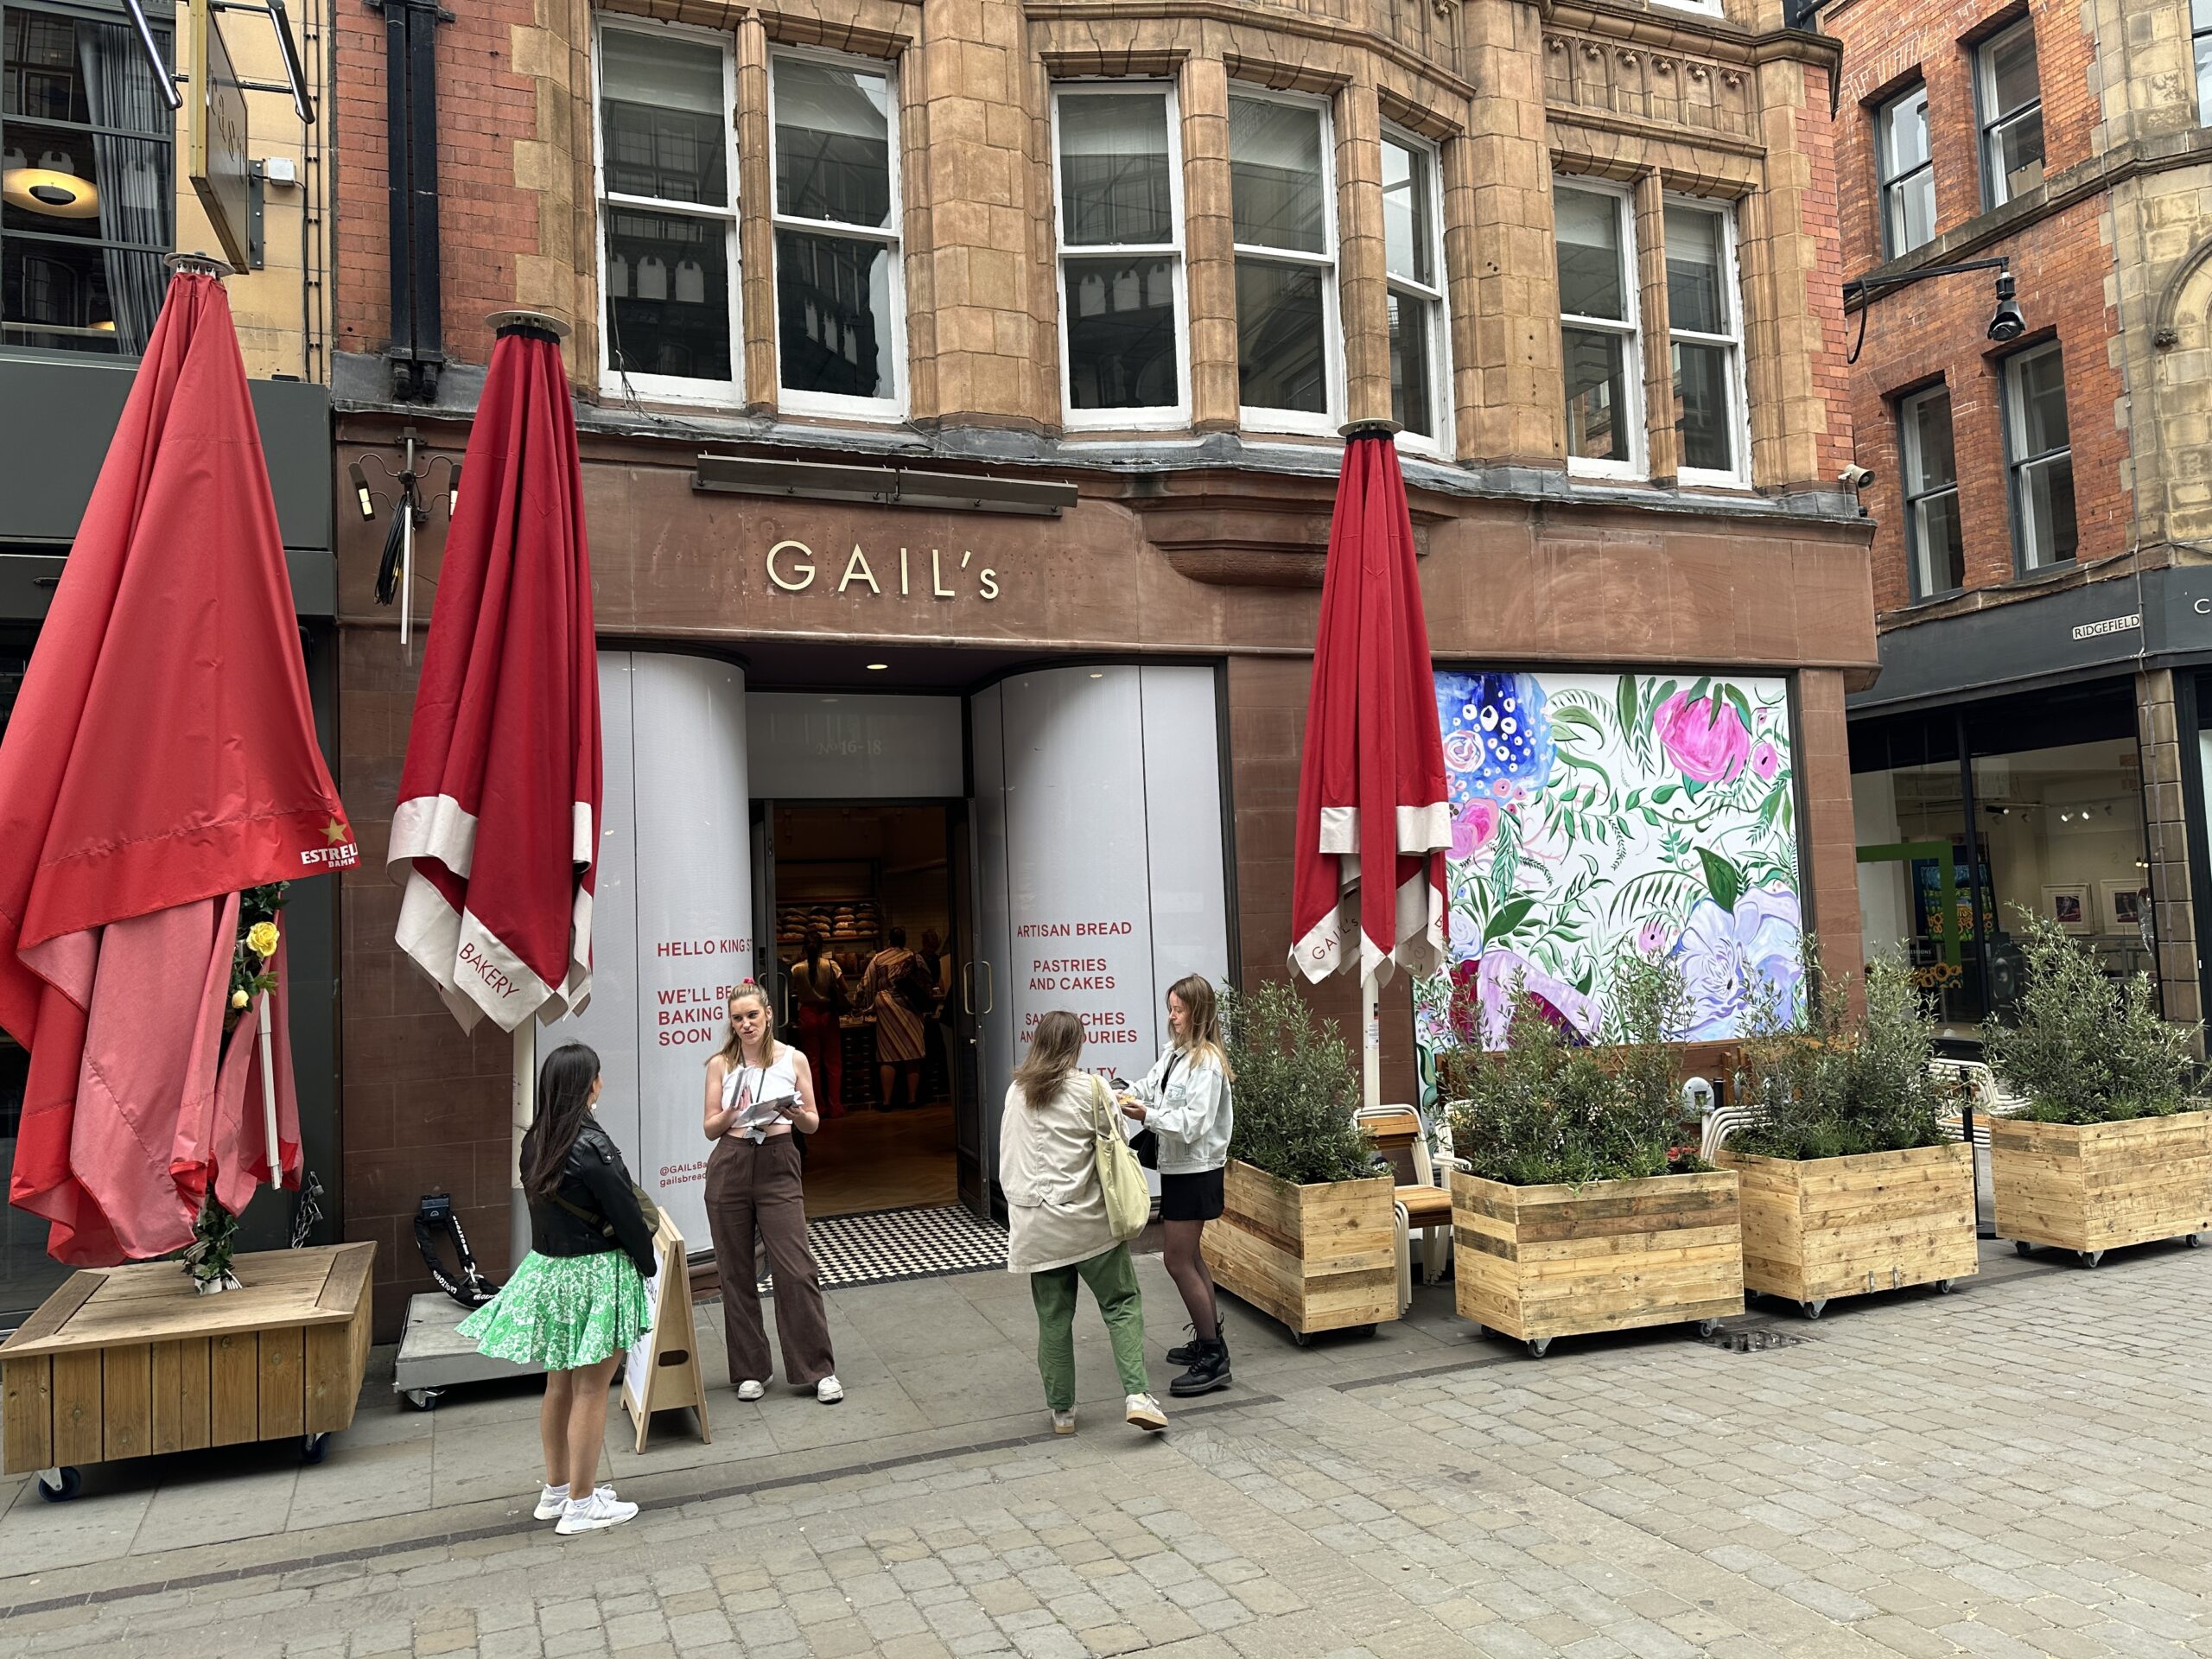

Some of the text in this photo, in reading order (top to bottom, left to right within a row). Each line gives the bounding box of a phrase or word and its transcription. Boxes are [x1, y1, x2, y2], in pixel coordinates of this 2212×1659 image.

[766, 539, 1000, 600] GAIL's
[2075, 615, 2140, 638] RIDGEFIELD
[328, 857, 355, 868] DAMM
[1017, 921, 1133, 938] ARTISAN BREAD
[658, 940, 715, 957] HELLO
[720, 938, 745, 953] KING
[459, 942, 520, 999] BAKERY
[1033, 958, 1107, 972] PASTRIES
[1029, 976, 1116, 990] AND CAKES
[658, 985, 732, 1005] WE'LL BE
[658, 1006, 723, 1026] BAKING
[1025, 1012, 1125, 1027] SACHES
[658, 1027, 712, 1046] SOON
[1020, 1030, 1033, 1043] AN
[659, 1161, 707, 1176] @GAILsBa
